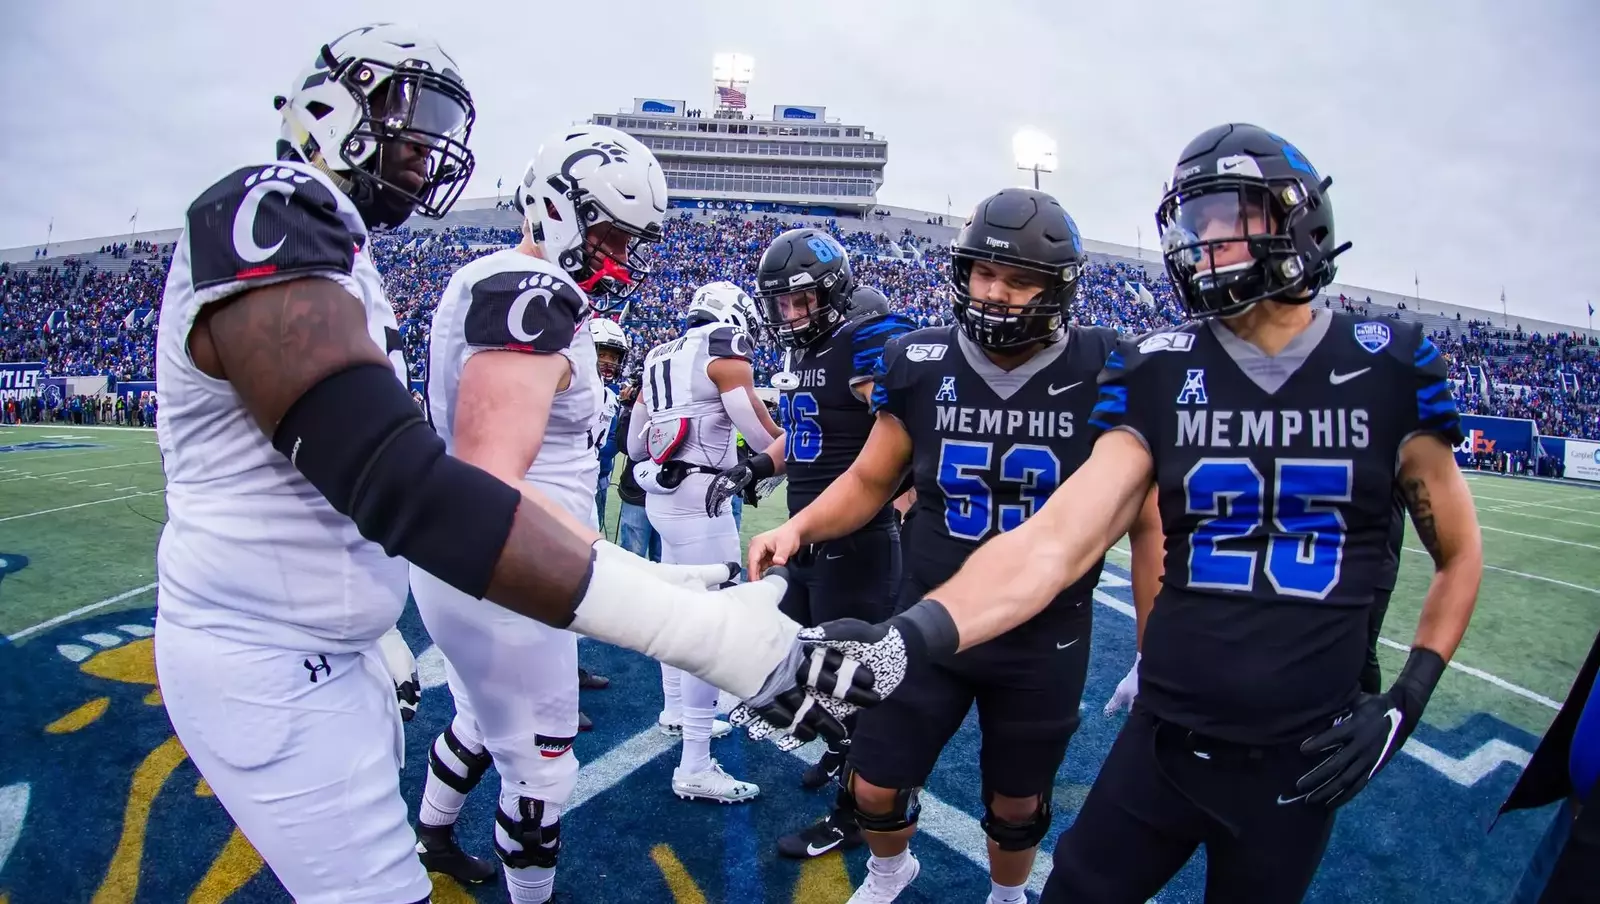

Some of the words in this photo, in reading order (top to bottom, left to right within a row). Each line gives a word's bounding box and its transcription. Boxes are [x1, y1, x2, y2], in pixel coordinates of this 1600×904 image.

[986, 236, 1010, 249] Tigers
[15, 370, 40, 388] LET
[649, 358, 673, 412] 11
[935, 405, 1075, 438] MEMPHIS
[1175, 408, 1370, 448] MEMPHIS
[936, 438, 1061, 541] 53
[1183, 457, 1354, 600] 25
